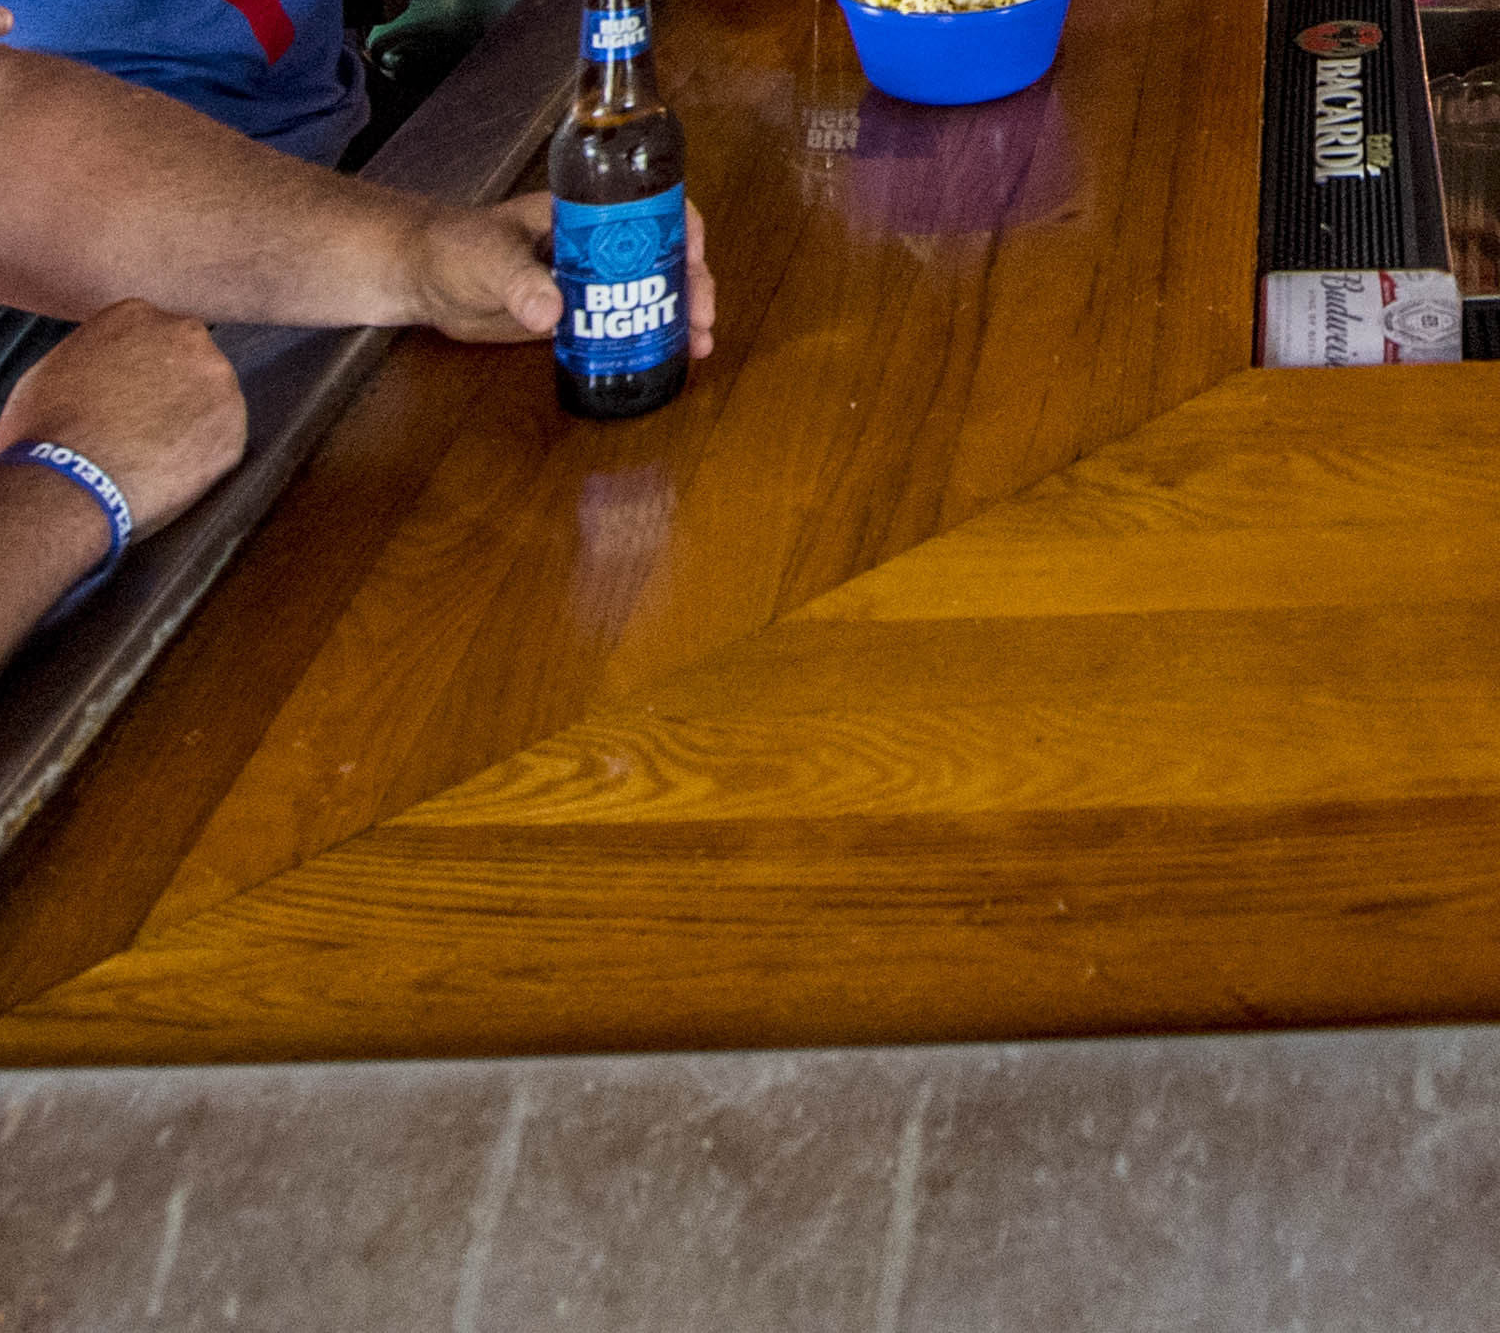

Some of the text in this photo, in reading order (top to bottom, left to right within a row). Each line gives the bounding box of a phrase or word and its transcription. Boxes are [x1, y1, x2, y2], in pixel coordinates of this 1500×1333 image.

[591, 25, 648, 51] LIGHT
[600, 15, 642, 35] BUD
[1313, 57, 1366, 185] BACARDI
[585, 274, 668, 314] BUD
[573, 295, 679, 340] LIGHT
